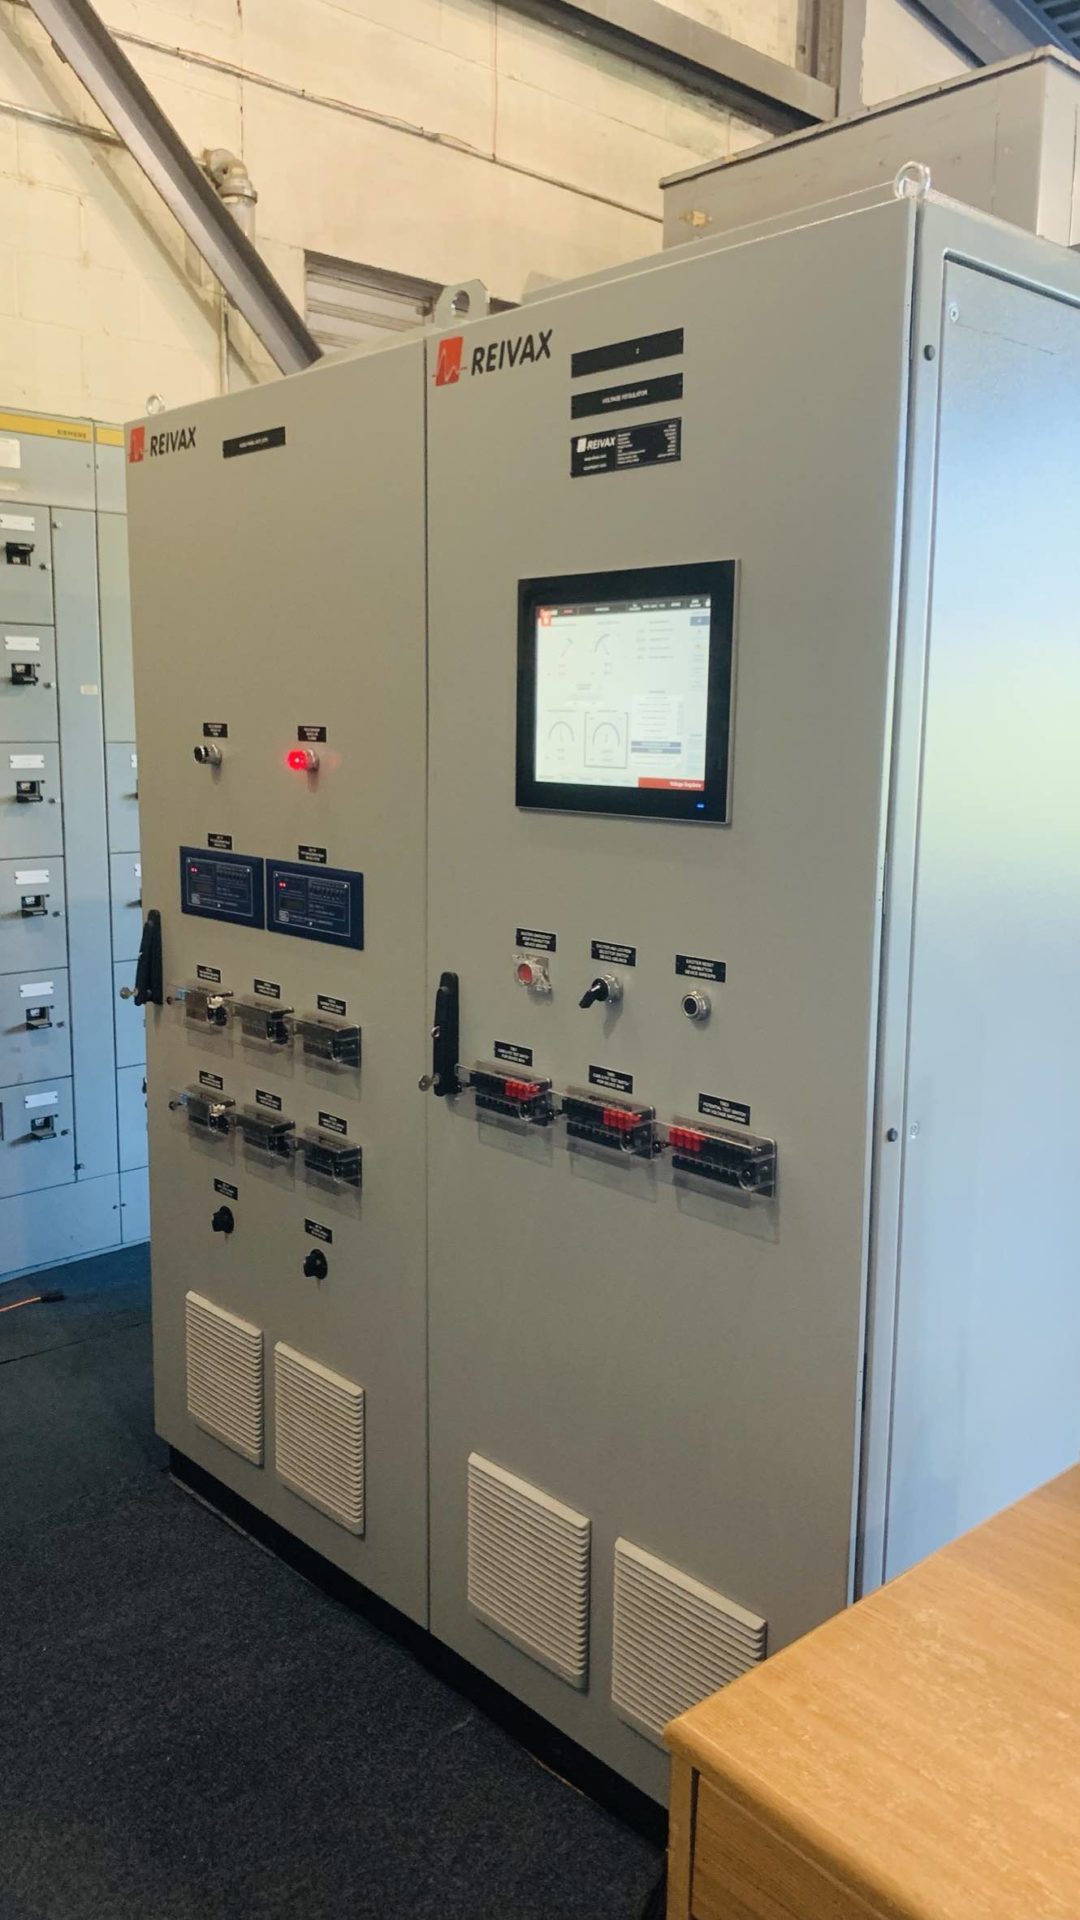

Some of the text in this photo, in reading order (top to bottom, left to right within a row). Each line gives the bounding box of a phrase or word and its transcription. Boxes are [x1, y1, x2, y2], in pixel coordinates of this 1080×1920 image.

[471, 329, 553, 376] REIVAX
[150, 426, 196, 457] REIVAX
[587, 436, 616, 450] REIVAX
